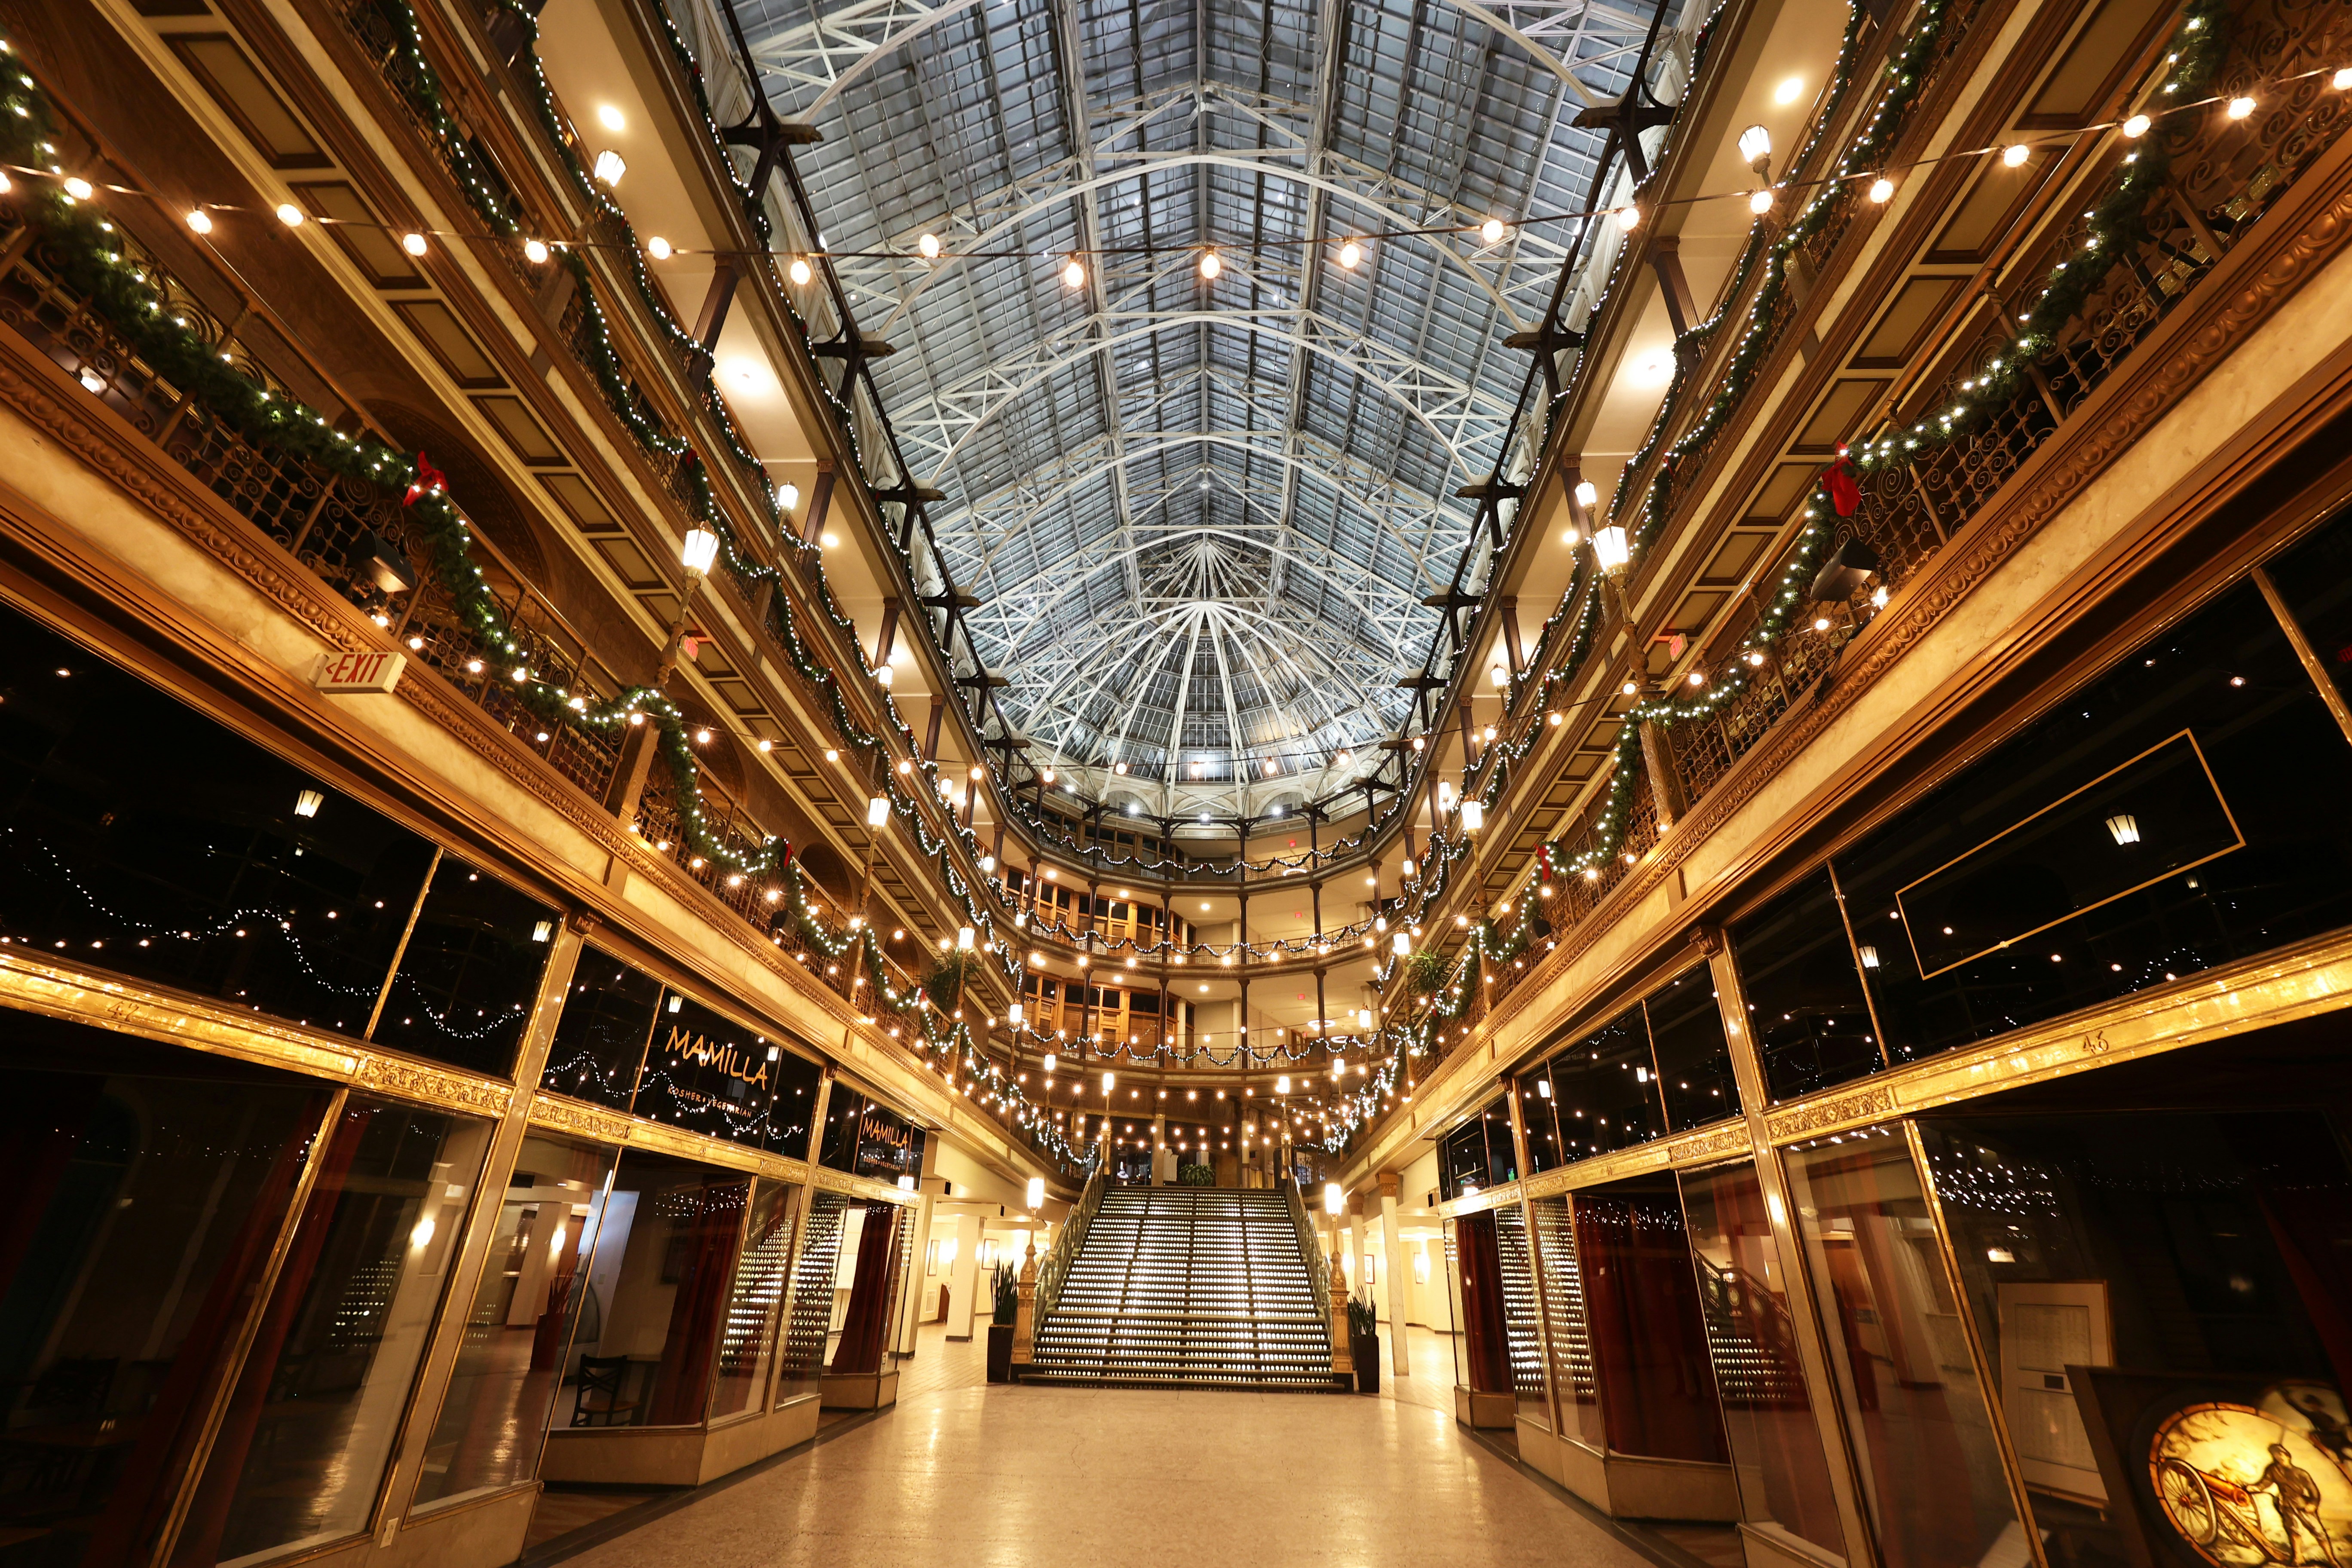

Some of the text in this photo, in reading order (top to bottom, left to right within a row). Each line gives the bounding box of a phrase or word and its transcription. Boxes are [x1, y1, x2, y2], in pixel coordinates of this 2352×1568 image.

[331, 654, 389, 683] EXIT
[665, 1025, 768, 1091] MAMILLA
[2083, 1031, 2109, 1054] 46
[668, 1086, 752, 1118] KOSHER VEGETARIAN
[862, 1117, 908, 1151] MAMILLA
